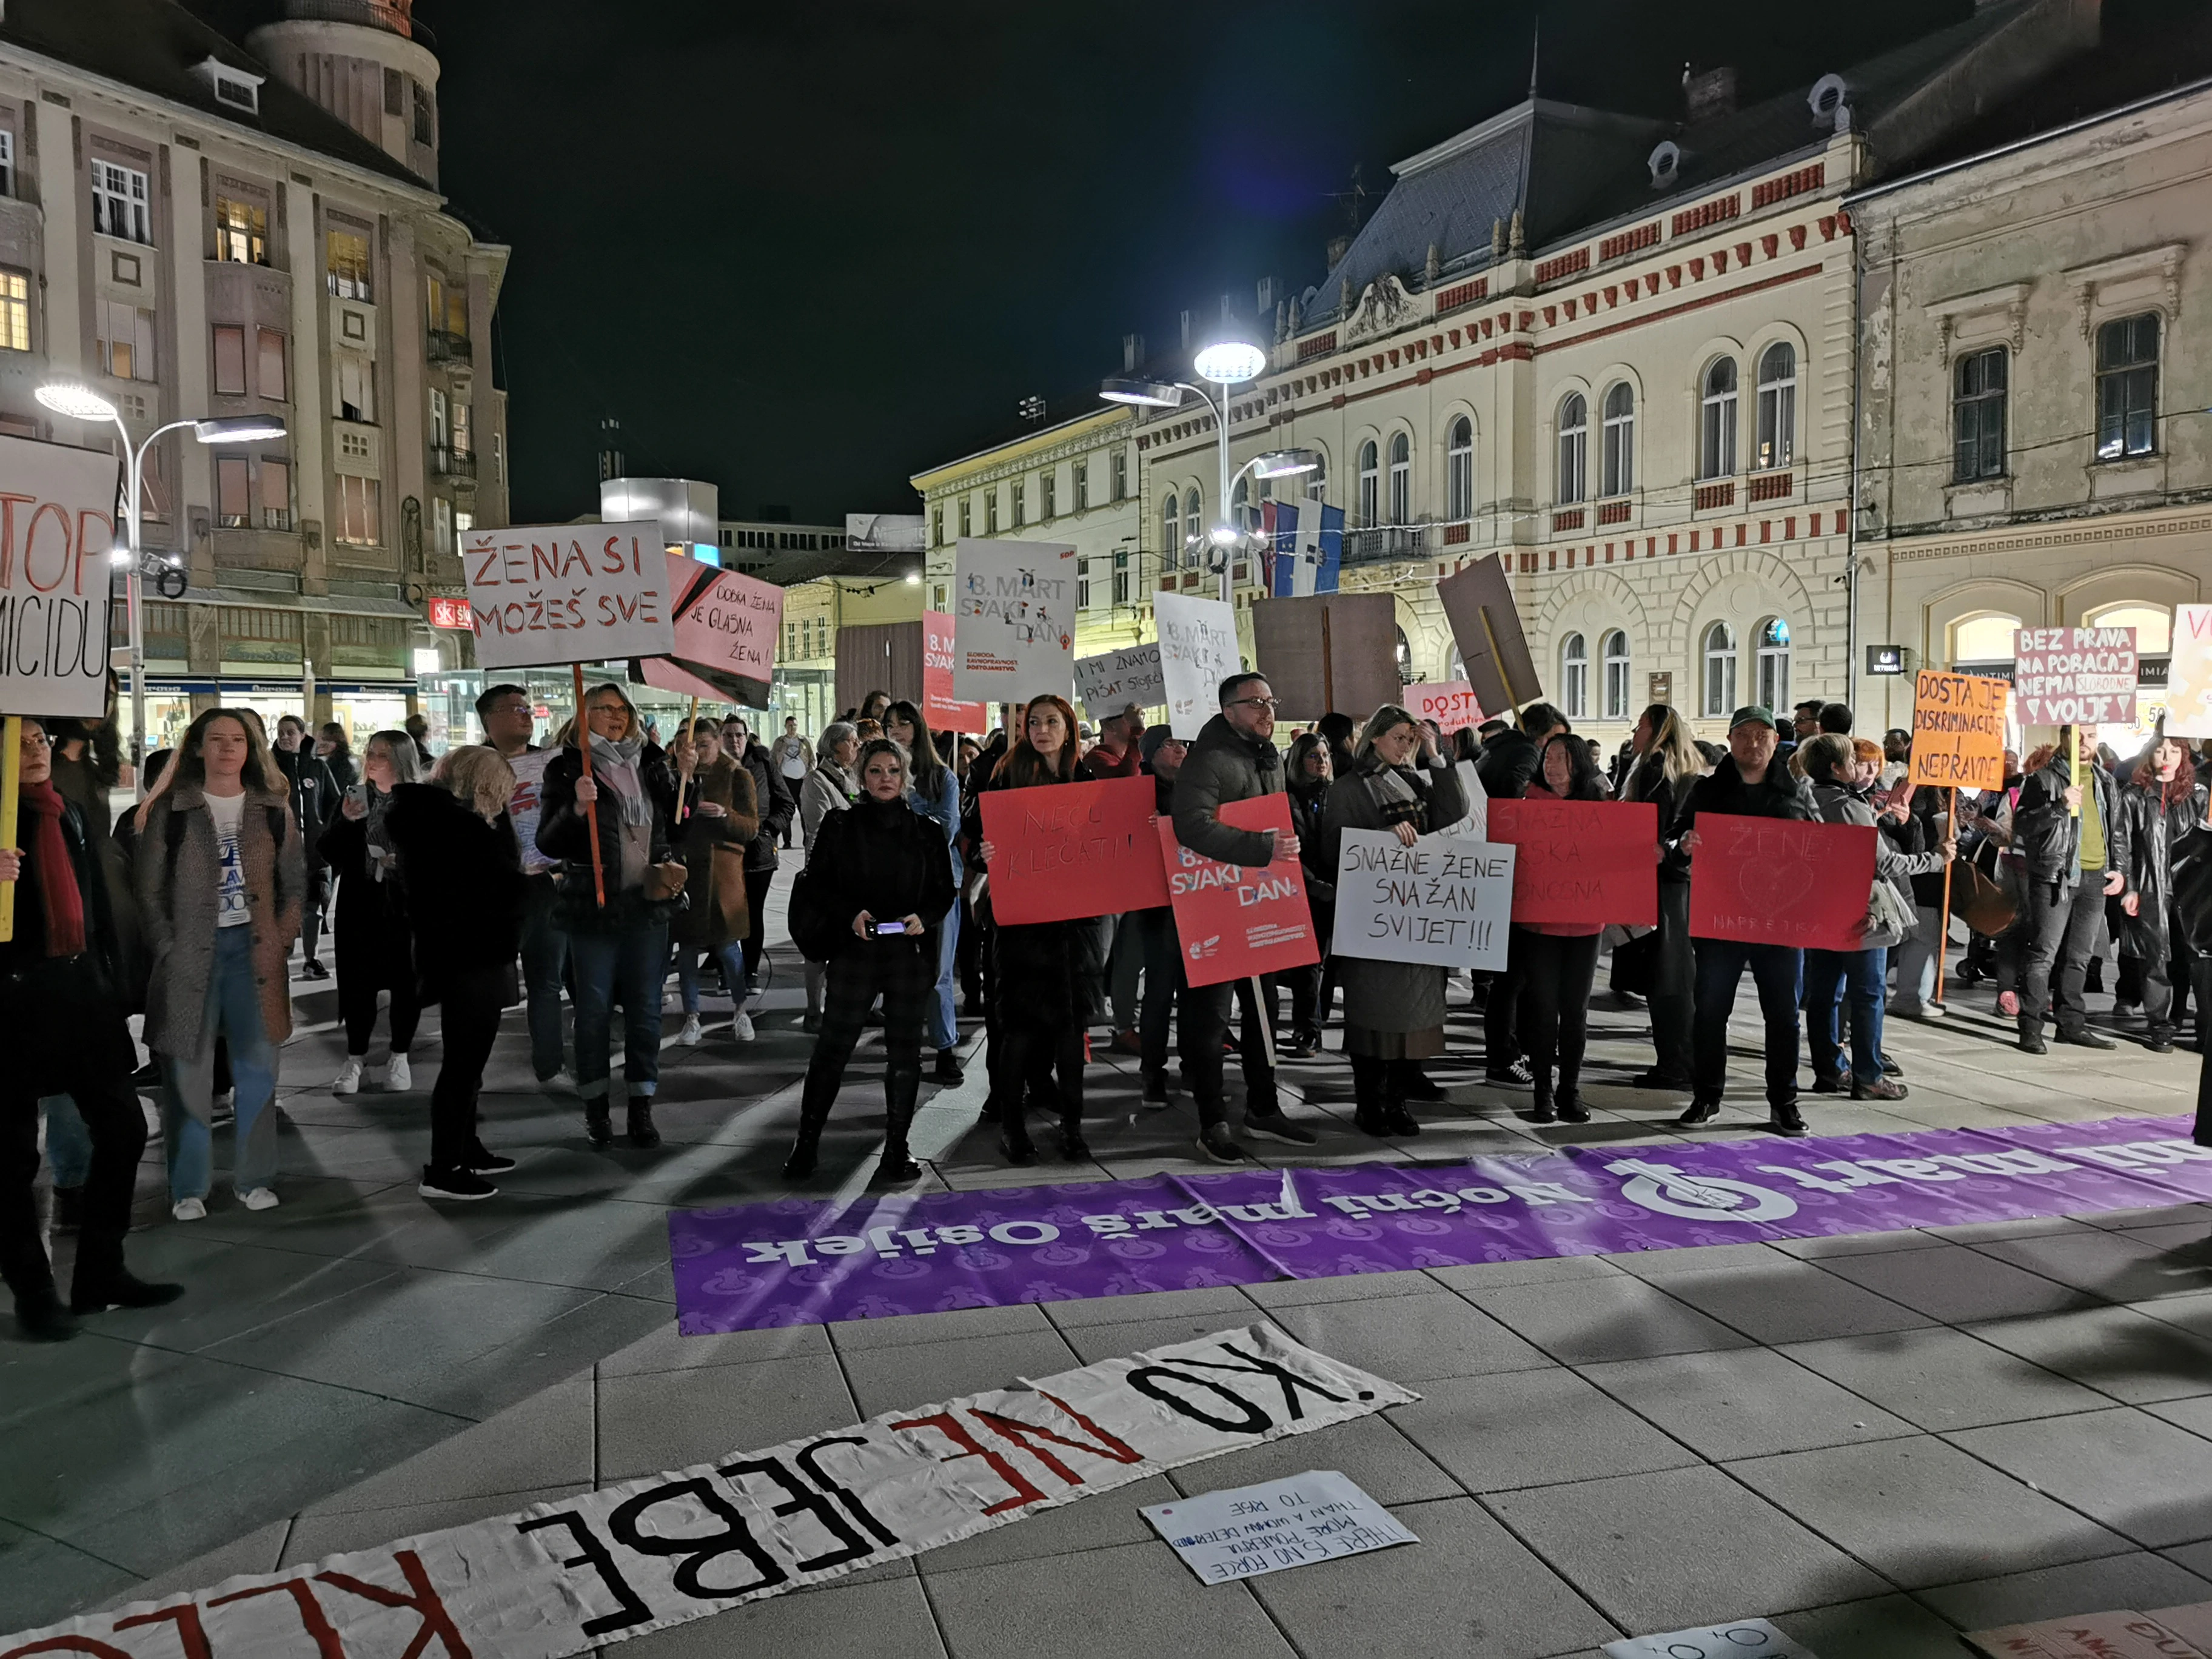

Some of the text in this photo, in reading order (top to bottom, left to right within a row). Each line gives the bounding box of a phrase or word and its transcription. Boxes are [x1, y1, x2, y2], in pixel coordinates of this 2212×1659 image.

[0, 492, 114, 595] TOP
[1060, 551, 1074, 560] SDP
[466, 535, 640, 586] ŽENA SI
[749, 591, 775, 614] ŽENA
[996, 576, 1066, 600] MART
[471, 587, 659, 638] MOŽEŠ SVE
[691, 606, 704, 623] JE
[0, 595, 107, 677] ICIDU
[1185, 625, 1228, 648] MART
[2020, 628, 2131, 652] BEZ PRAVA
[925, 652, 955, 670] SVAK
[1078, 649, 1160, 679] I MI ZNAMO
[2018, 647, 2134, 675] NA POBAČAJ
[1920, 675, 2005, 711] DOSTA JE
[2018, 675, 2131, 697] NEMA SLOBODNE
[1423, 692, 1480, 718] DOST
[1915, 709, 2004, 736] DISKRIMINACIJE
[1957, 736, 1961, 752] I
[1344, 842, 1508, 879] SNAŽNE ŽENE
[1171, 864, 1242, 894] SVAKI
[1373, 877, 1476, 913] SNAŽAN
[1757, 1148, 2082, 1193] mart
[1323, 1180, 1594, 1218] Noćni
[1089, 1202, 1318, 1240] marš
[742, 1219, 1062, 1267] Osijek
[890, 1390, 1145, 1516] NE
[1228, 1491, 1309, 1517] TO RISE
[1292, 1512, 1303, 1523] A
[1309, 1500, 1362, 1519] THAN
[515, 1436, 900, 1637] JEBE
[1219, 1514, 1356, 1555] MORE POWERFUL
[1242, 1517, 1290, 1534] WOMAN
[1209, 1523, 1407, 1578] THERE IS NO FORCE
